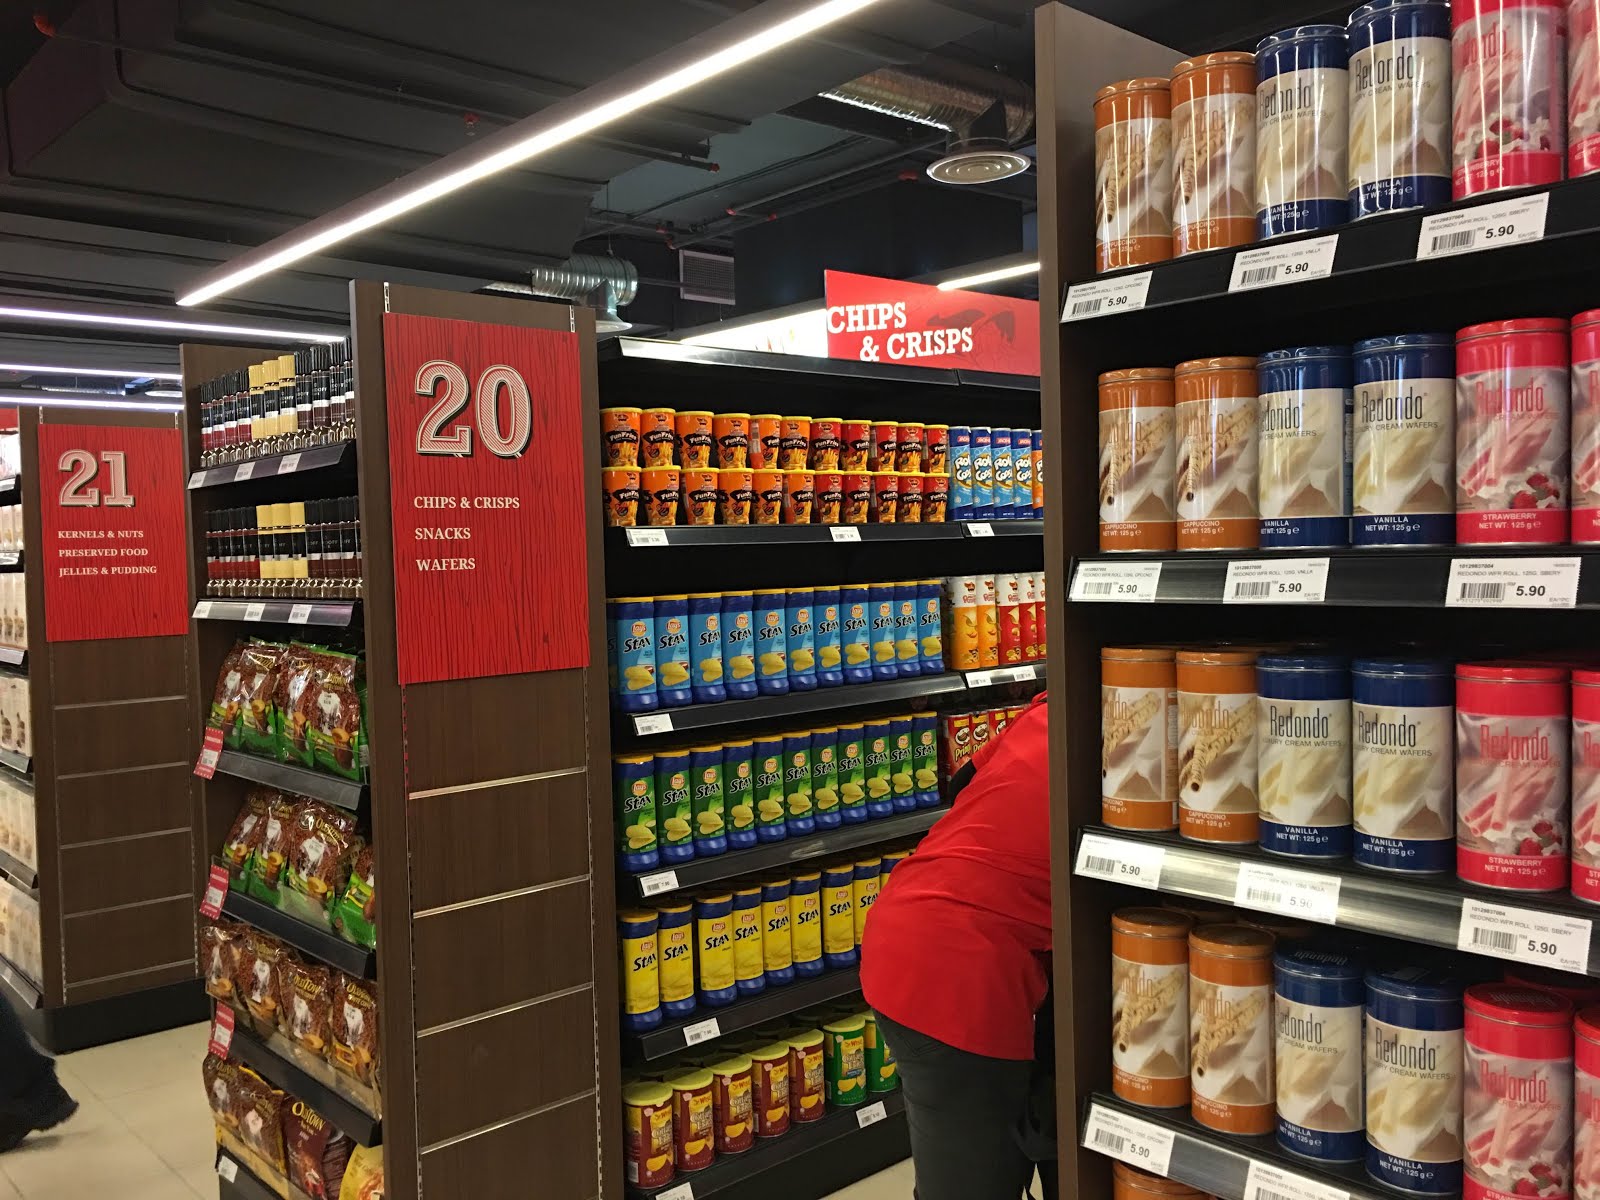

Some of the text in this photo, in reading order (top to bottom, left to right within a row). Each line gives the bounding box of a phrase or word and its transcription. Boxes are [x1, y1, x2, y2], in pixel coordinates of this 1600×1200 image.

[1485, 224, 1515, 239] 5.90
[1285, 262, 1309, 275] 5.90
[1107, 295, 1128, 307] 5.90
[827, 301, 907, 334] CHIPS
[859, 327, 973, 361] & CRISPS
[414, 359, 532, 459] 20
[1361, 386, 1423, 424] Redondo
[1405, 421, 1438, 430] WAFERS
[1286, 429, 1317, 438] WAFERS
[58, 449, 135, 508] 21
[413, 496, 520, 510] CHIPS & CRISPS
[1373, 516, 1409, 524] VANILLA
[1482, 512, 1537, 521] STRAWBERRY
[1365, 523, 1377, 531] NET
[1378, 523, 1390, 531] WT:
[1391, 523, 1404, 532] 125
[1493, 521, 1509, 529] WT:
[1511, 521, 1525, 529] 125
[58, 530, 144, 539] KERNELS & NUTS
[414, 527, 471, 540] SNACKS
[1119, 529, 1129, 537] 125
[1200, 527, 1210, 535] 125
[1276, 527, 1285, 535] 125
[58, 548, 149, 557] PRESERVED FOOD
[416, 558, 476, 571] WAFERS
[59, 566, 157, 577] JELLIES & PUDDING
[1118, 584, 1138, 593] 5.90
[1278, 583, 1302, 593] 5.90
[1516, 585, 1546, 596] 5.90
[1270, 705, 1328, 739] Redondo
[1358, 711, 1416, 748] Redondo
[1285, 739, 1342, 748] CREAM WAFERS
[1480, 724, 1549, 761] Redondo
[1371, 747, 1433, 757] CREAM WAFERS
[1188, 810, 1226, 821] CAPPUCCINO
[1285, 826, 1319, 835] VANILLA
[1276, 832, 1287, 840] NET
[1288, 834, 1302, 842] WT:
[1303, 835, 1315, 843] 125
[1370, 837, 1404, 848] VANILLA
[1362, 843, 1373, 852] NET
[1374, 845, 1386, 854] WT:
[1387, 847, 1399, 855] 125
[1488, 856, 1543, 866] STRAWBERRY
[1120, 864, 1141, 876] 5.90
[1484, 864, 1500, 872] NET
[1502, 866, 1516, 874] WT:
[1518, 867, 1531, 875] 125
[1289, 896, 1313, 909] 5.90
[1527, 940, 1557, 956] 5.90
[1307, 1044, 1338, 1055] WAFERS
[1375, 1027, 1436, 1072] Redondo
[1389, 1067, 1451, 1081] CREAM WAFERS
[1481, 1059, 1546, 1104] Redondo
[1284, 1121, 1312, 1137] VANILLA
[1297, 1133, 1308, 1143] 125
[1130, 1143, 1150, 1158] 5.90
[1388, 1155, 1423, 1171] VANILLA
[1380, 1160, 1391, 1170] NET
[1391, 1164, 1405, 1175] WT:
[1405, 1168, 1419, 1179] 125
